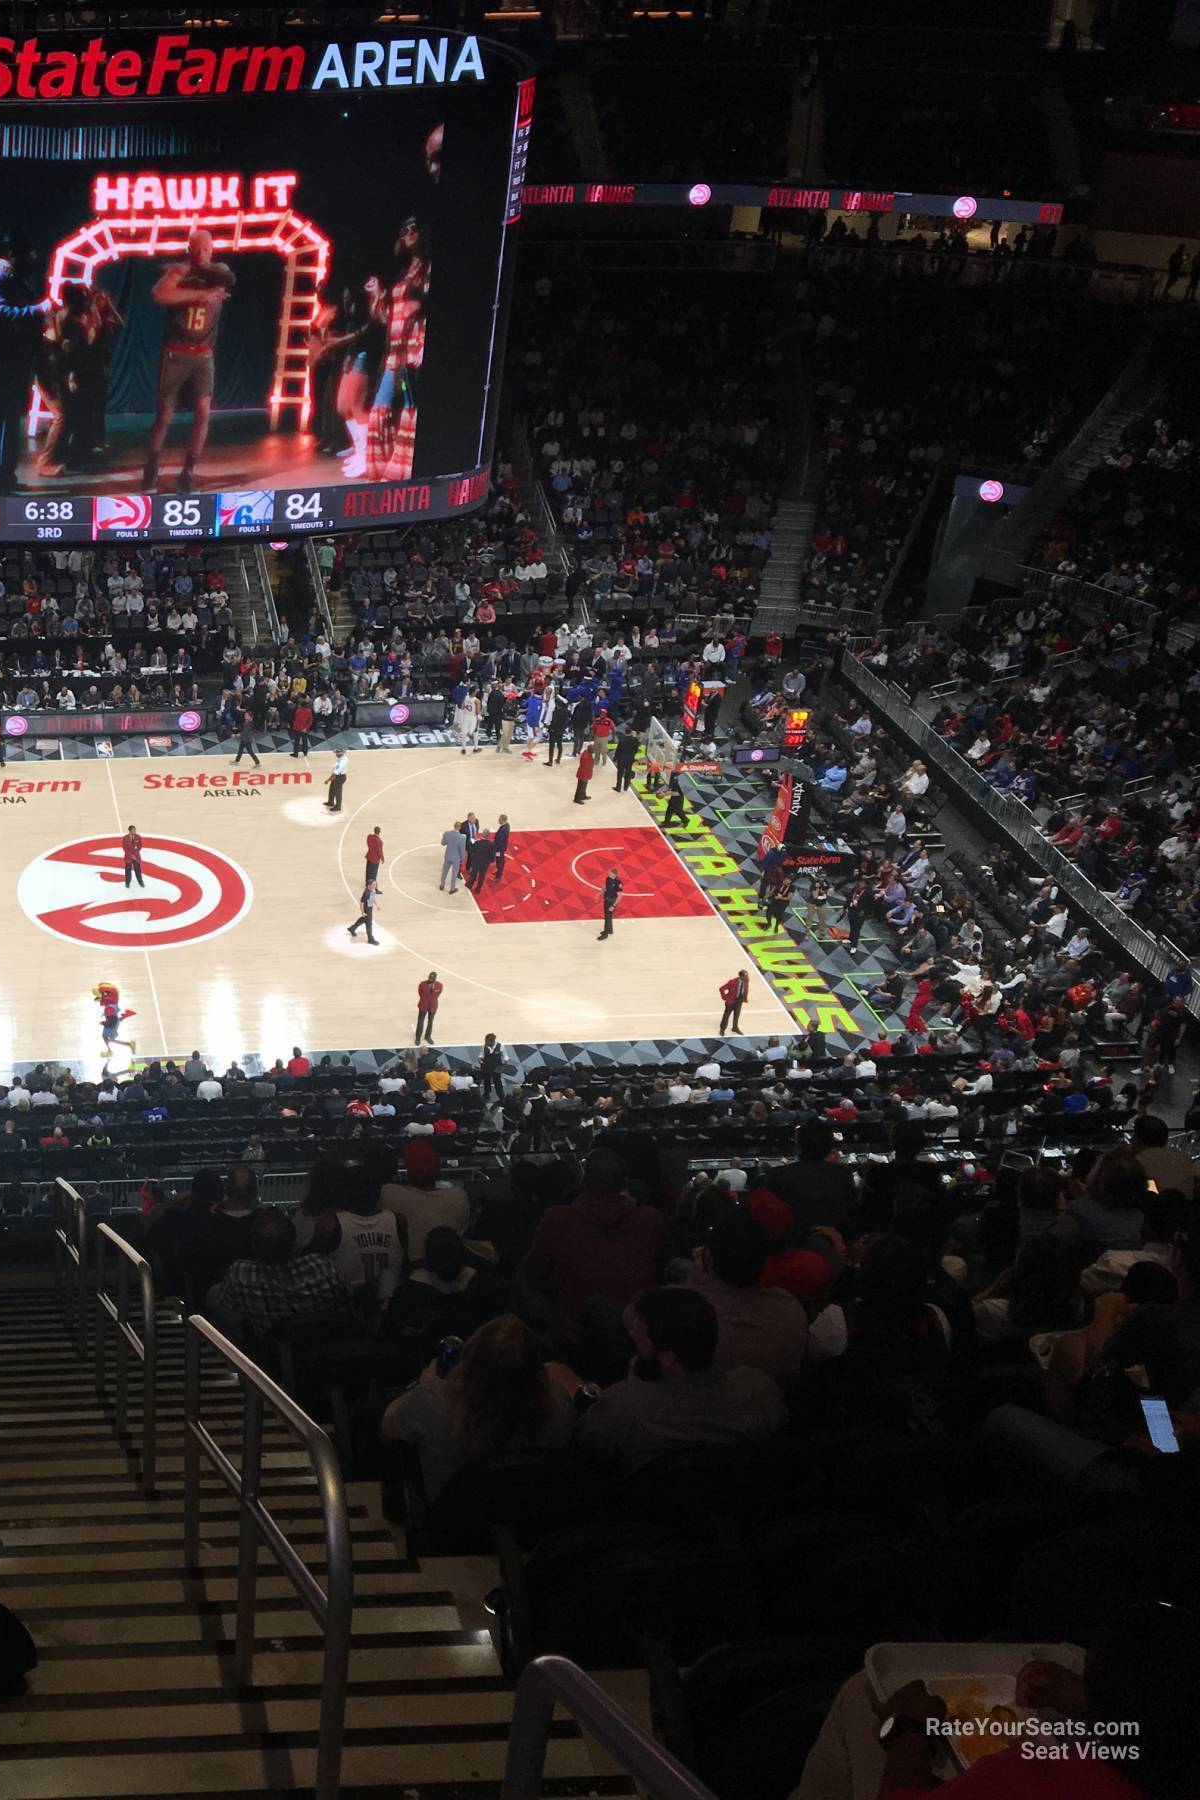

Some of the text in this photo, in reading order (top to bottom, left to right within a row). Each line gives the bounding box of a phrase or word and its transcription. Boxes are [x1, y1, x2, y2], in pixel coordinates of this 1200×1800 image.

[312, 35, 485, 89] ARENA
[95, 175, 296, 210] HAWK IT
[25, 502, 74, 520] 6:38
[285, 493, 323, 520] 84
[343, 485, 432, 519] ATLANTA
[163, 500, 201, 526] 85
[37, 528, 63, 538] 3RD
[169, 529, 203, 537] TIMEOUTS
[291, 521, 324, 530] TIMEOUTS
[203, 788, 262, 797] ARENA
[354, 1232, 392, 1249] YOUNG
